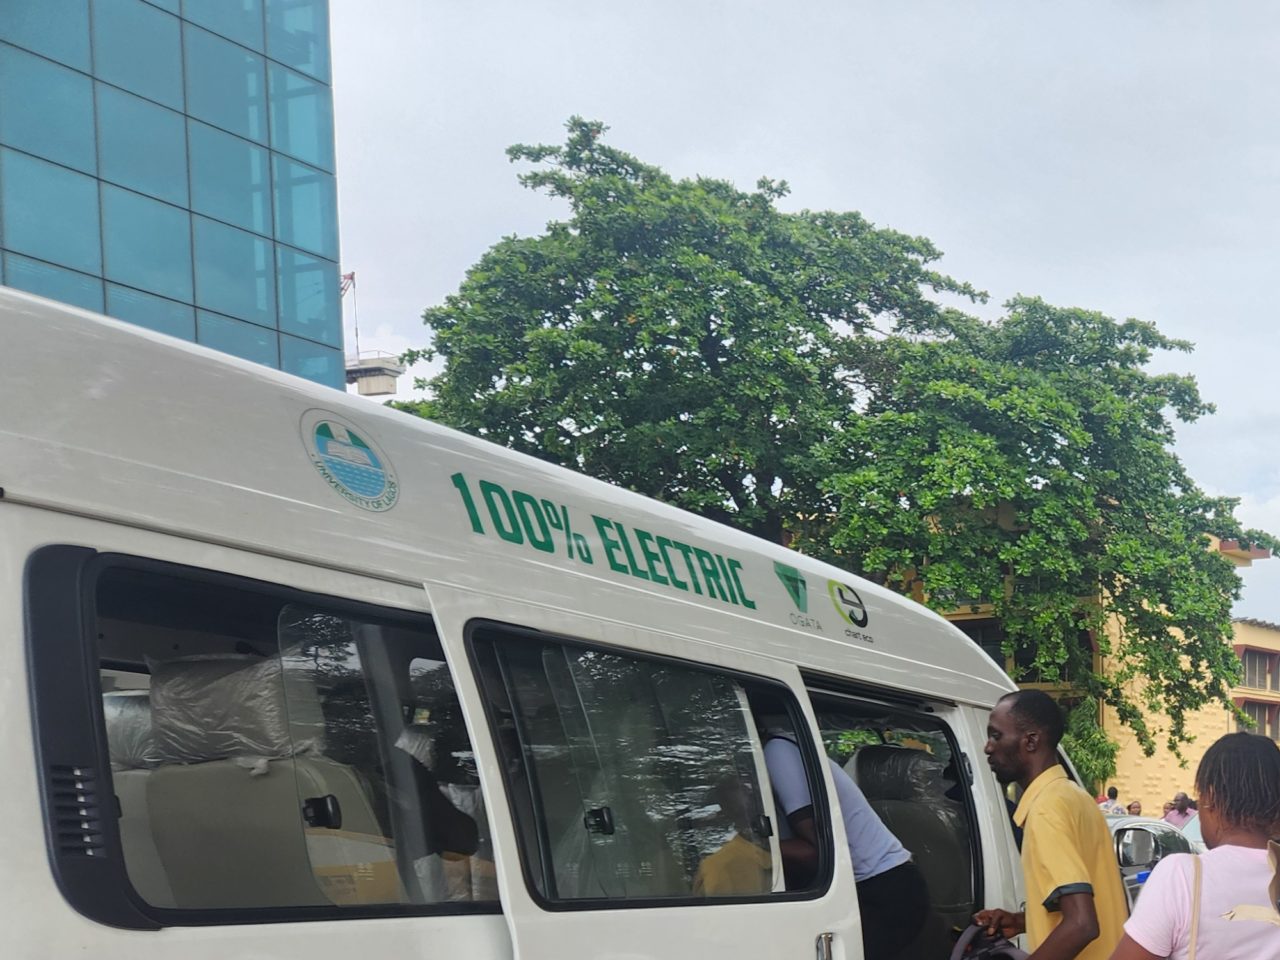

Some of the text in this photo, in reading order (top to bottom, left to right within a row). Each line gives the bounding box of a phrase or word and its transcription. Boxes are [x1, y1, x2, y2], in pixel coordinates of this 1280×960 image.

[314, 460, 371, 508] UNIVERSITY
[450, 472, 756, 610] 100% ELECTRIC
